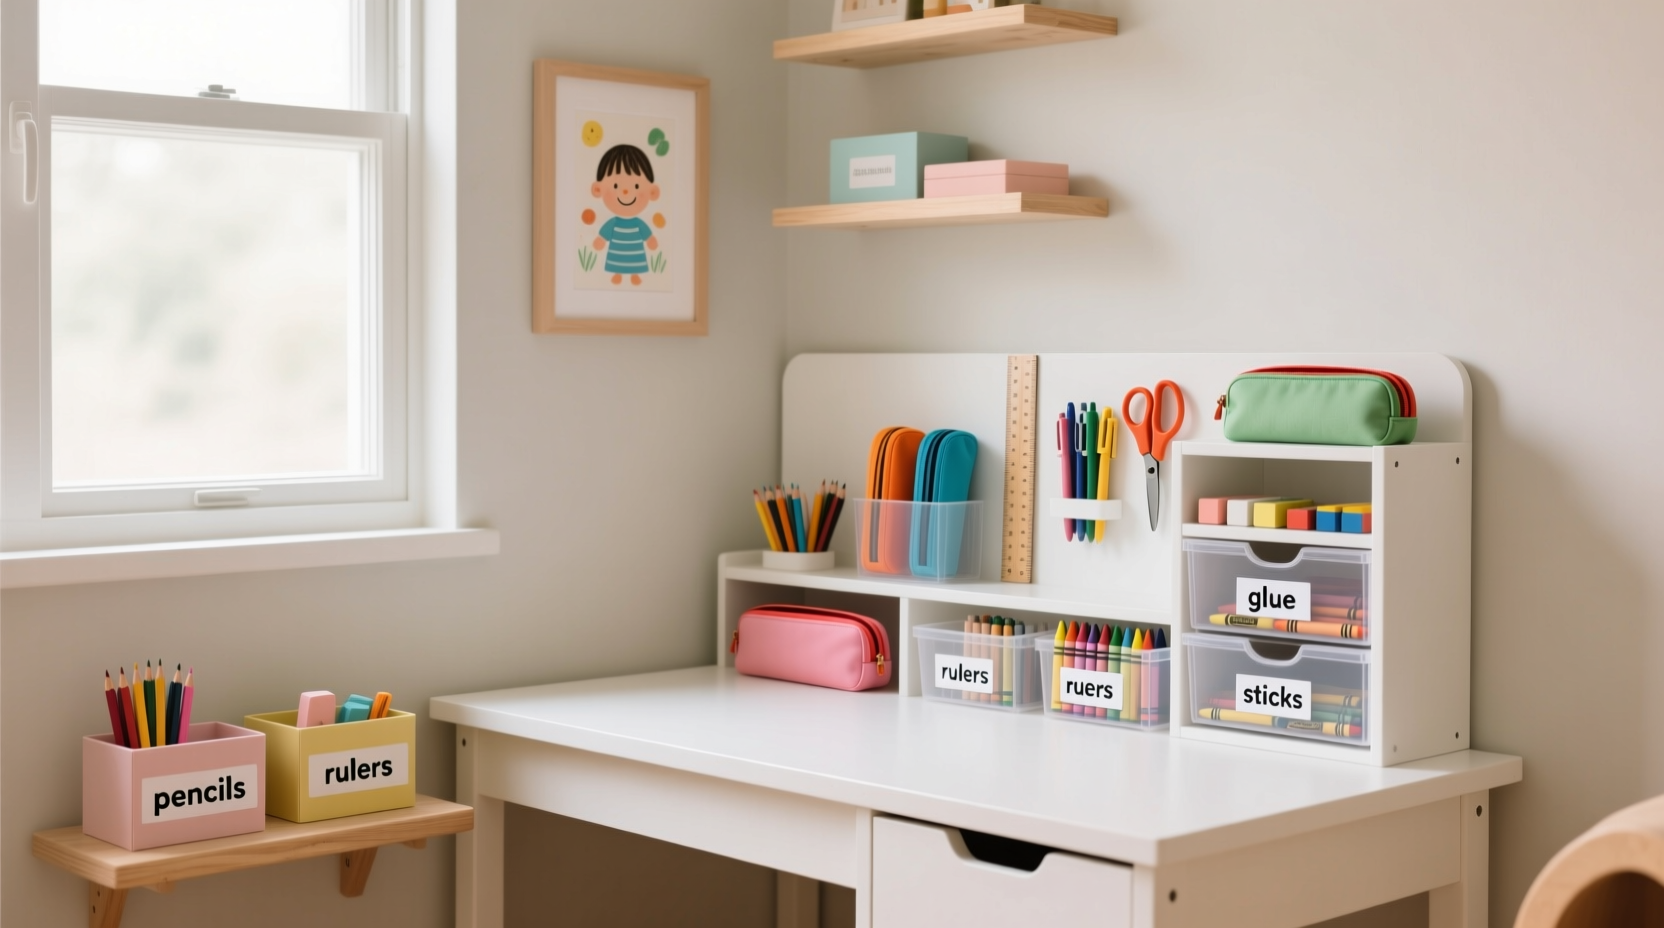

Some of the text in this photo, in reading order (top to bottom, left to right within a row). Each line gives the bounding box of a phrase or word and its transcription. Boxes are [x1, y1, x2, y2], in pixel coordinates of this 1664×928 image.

[1248, 585, 1296, 613] glue
[941, 662, 989, 685] rulers
[1066, 680, 1114, 700] ruers
[1243, 684, 1303, 709] sticks
[324, 757, 393, 785] rulers
[154, 775, 246, 816] pencils
